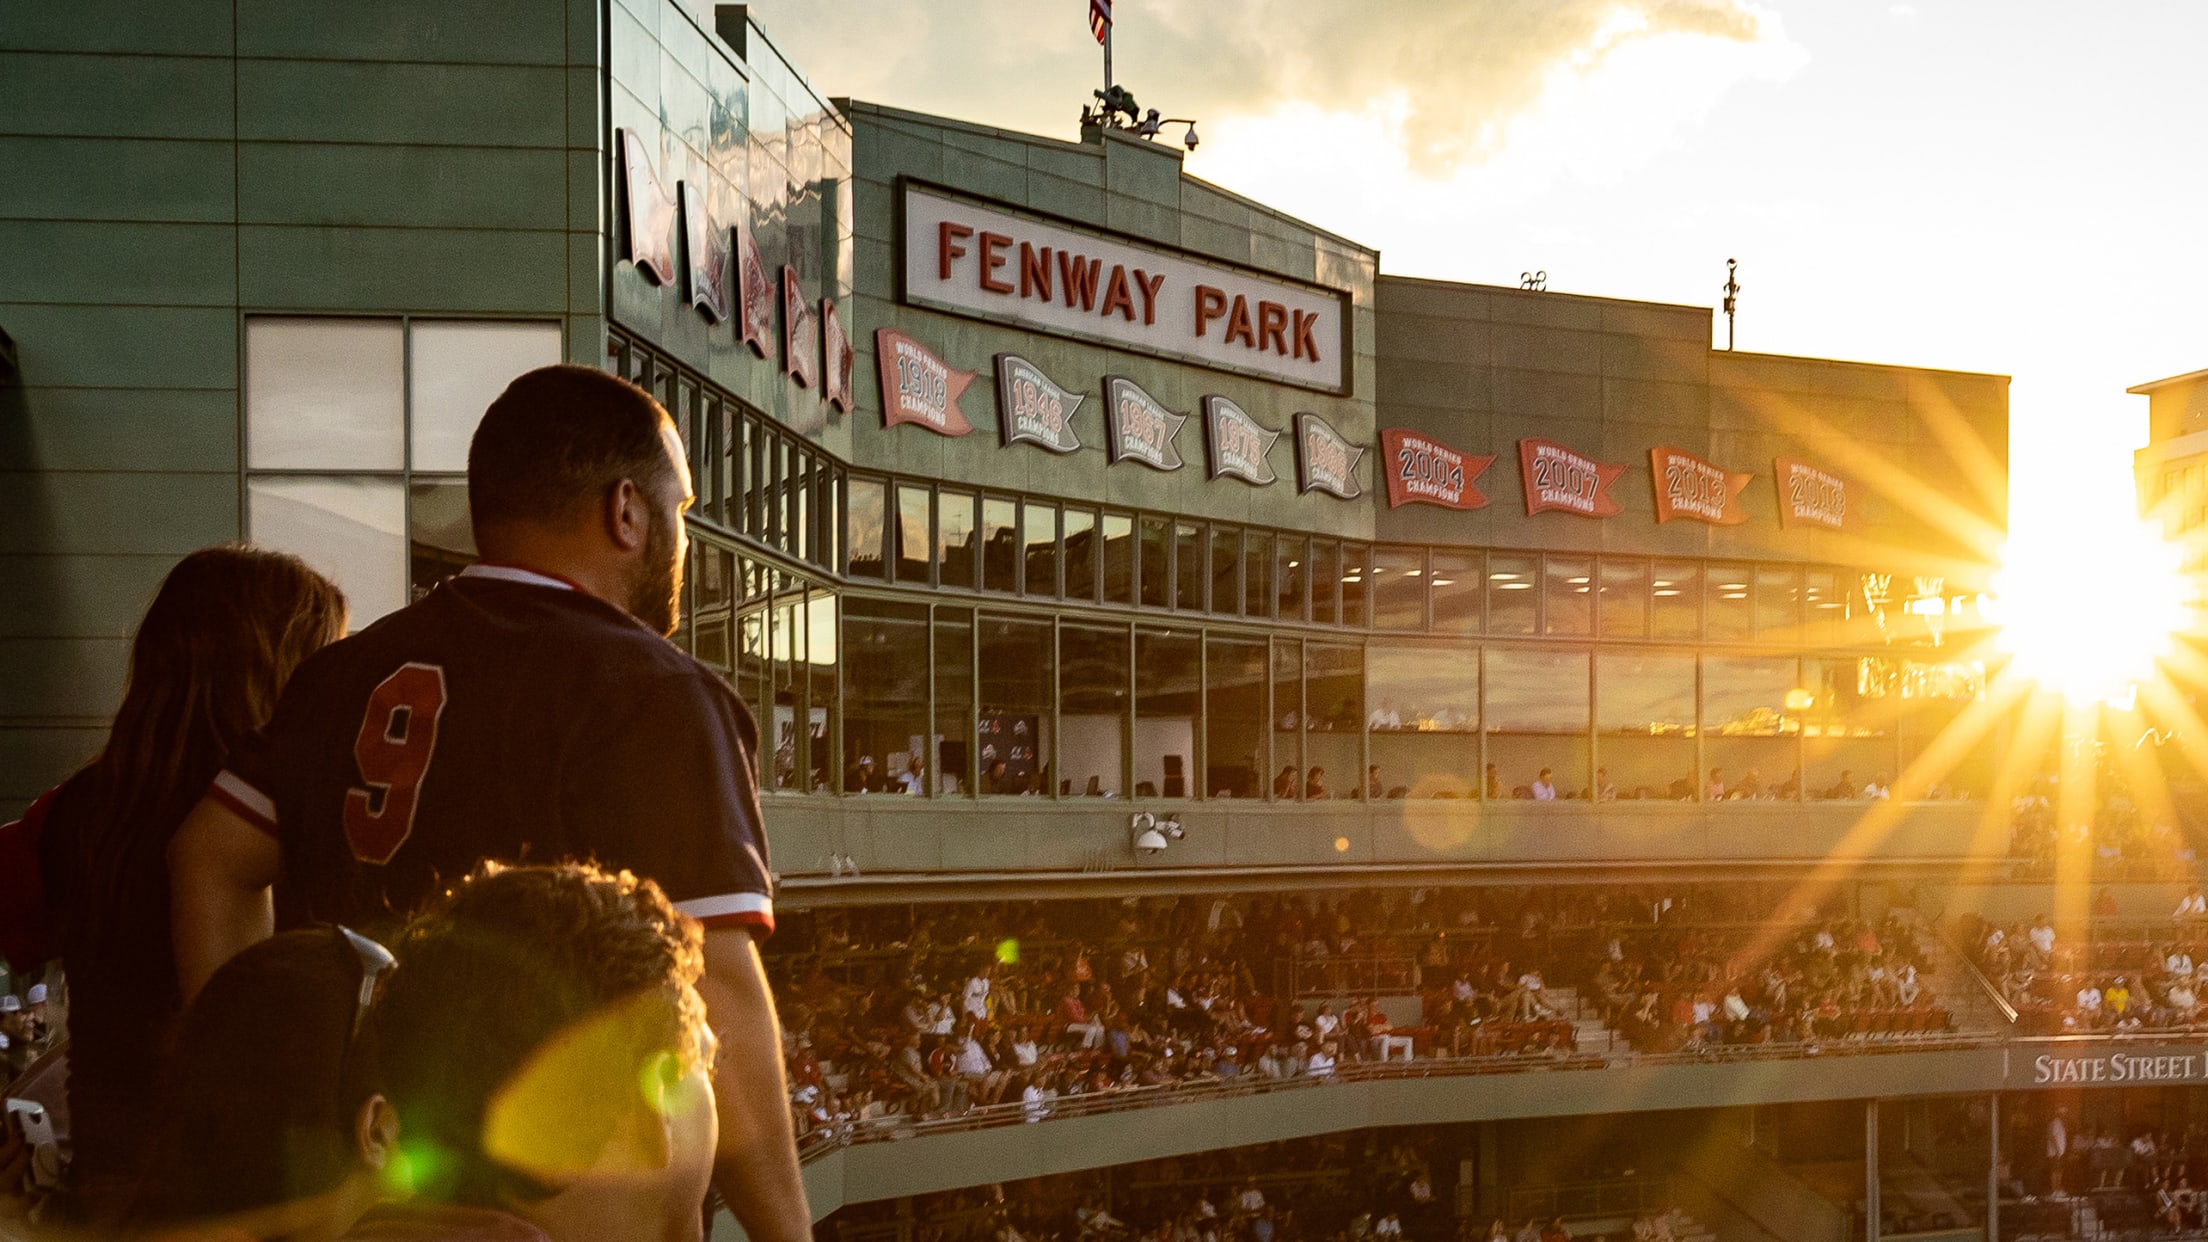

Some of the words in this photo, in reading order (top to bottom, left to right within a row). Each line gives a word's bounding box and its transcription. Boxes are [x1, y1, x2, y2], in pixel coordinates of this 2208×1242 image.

[938, 221, 1166, 326] FENWAY
[1194, 284, 1320, 363] PARK
[896, 341, 922, 361] WORLD
[923, 354, 948, 380] SERIES
[897, 356, 947, 412] 1918
[1013, 367, 1041, 388] AMERICAN
[1041, 381, 1060, 401] LEAGUE
[901, 394, 946, 427] CHAMPIONS
[1013, 379, 1062, 433] 1946
[1018, 416, 1059, 446] CHAMPIONS
[1121, 400, 1166, 450] 1967
[1219, 417, 1261, 466] 1975
[1124, 435, 1163, 464] CHAMPIONS
[1223, 452, 1258, 479] CHAMPIONS
[1402, 437, 1432, 452] WORLD
[1433, 446, 1462, 466] SERIES
[1537, 446, 1567, 461] WORLD
[1567, 454, 1596, 473] SERIES
[1398, 447, 1464, 494] 2004
[1533, 457, 1599, 502] 2007
[1668, 455, 1697, 471] WORLD
[1697, 462, 1724, 480] SERIES
[1791, 464, 1818, 479] WORLD
[1818, 471, 1844, 491] SERIES
[1406, 481, 1460, 503] CHAMPIONS
[1541, 489, 1595, 512] CHAMPIONS
[1666, 466, 1726, 508] 2013
[1789, 475, 1846, 516] 2018
[1671, 497, 1722, 520] CHAMPIONS
[1794, 504, 1842, 527] CHAMPIONS
[343, 661, 448, 865] 9
[2034, 1054, 2107, 1084] STATE
[2109, 1052, 2199, 1082] STREET
